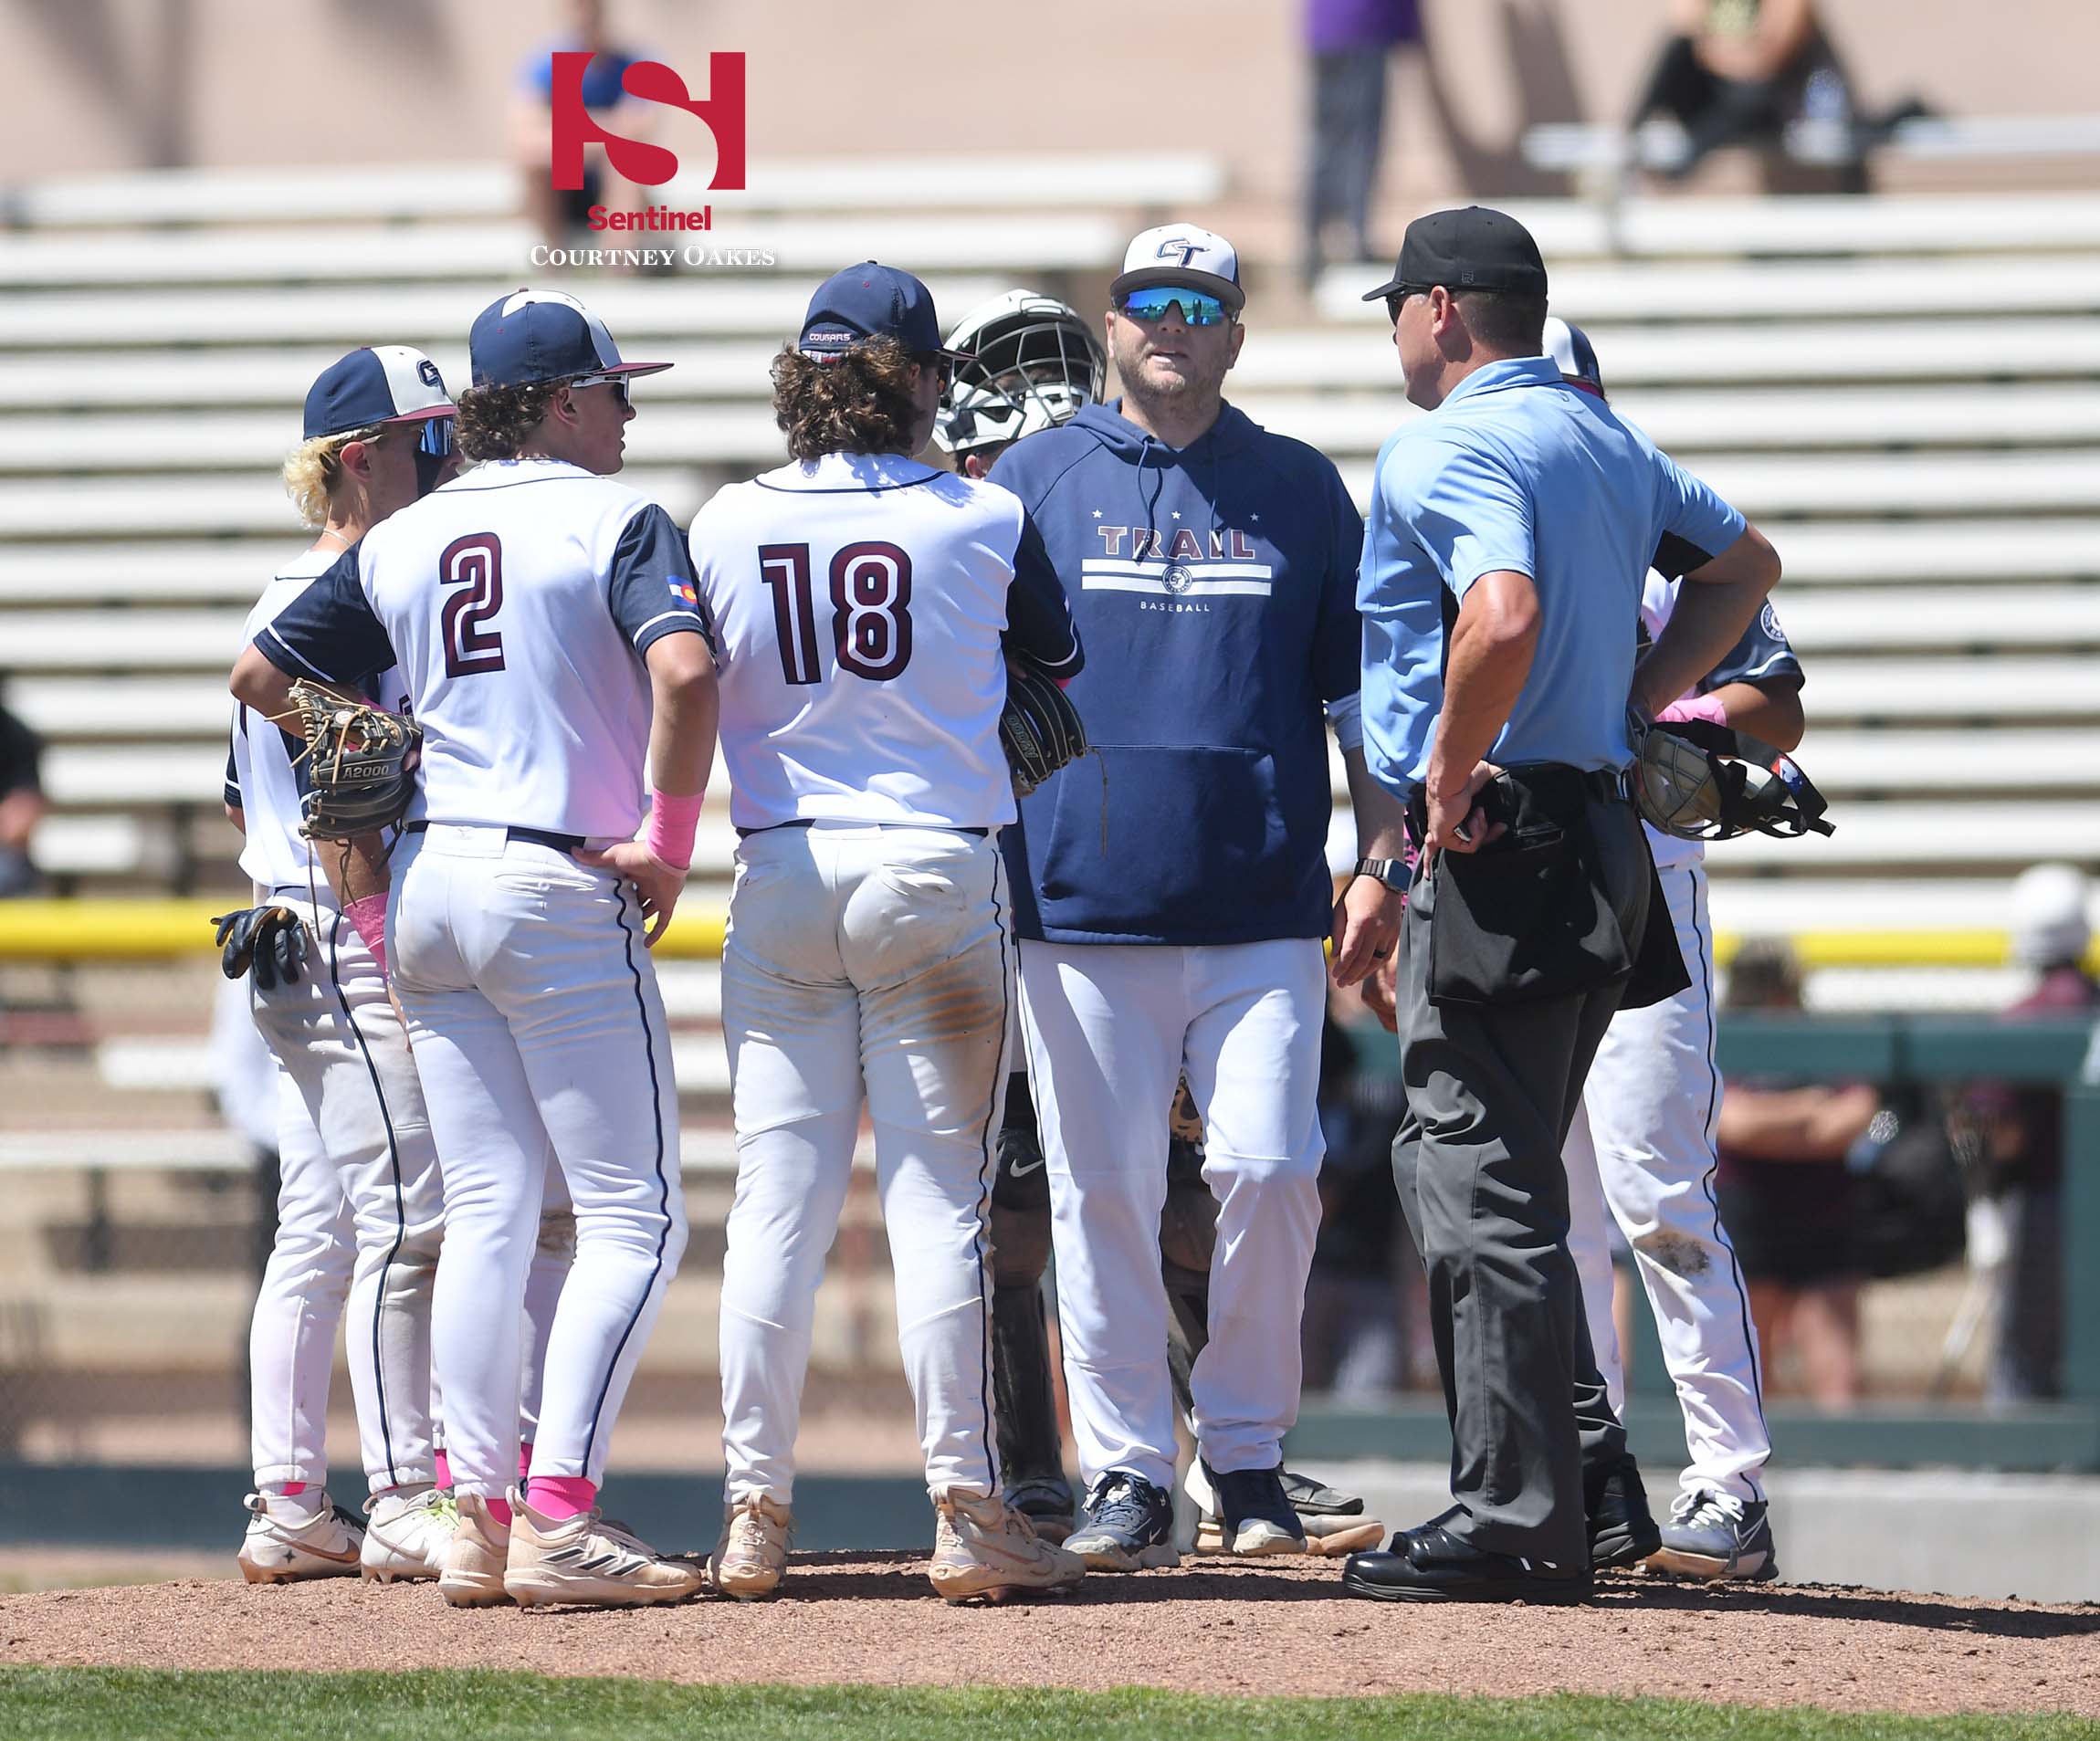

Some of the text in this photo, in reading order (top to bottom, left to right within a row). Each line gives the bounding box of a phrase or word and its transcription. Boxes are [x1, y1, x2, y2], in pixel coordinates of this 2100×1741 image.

[809, 332, 852, 343] COUGARS
[1097, 526, 1255, 560] TRAIL
[439, 531, 506, 679] 2
[758, 540, 912, 686] 18
[1139, 601, 1211, 613] BASEBALL
[343, 765, 389, 779] A2000
